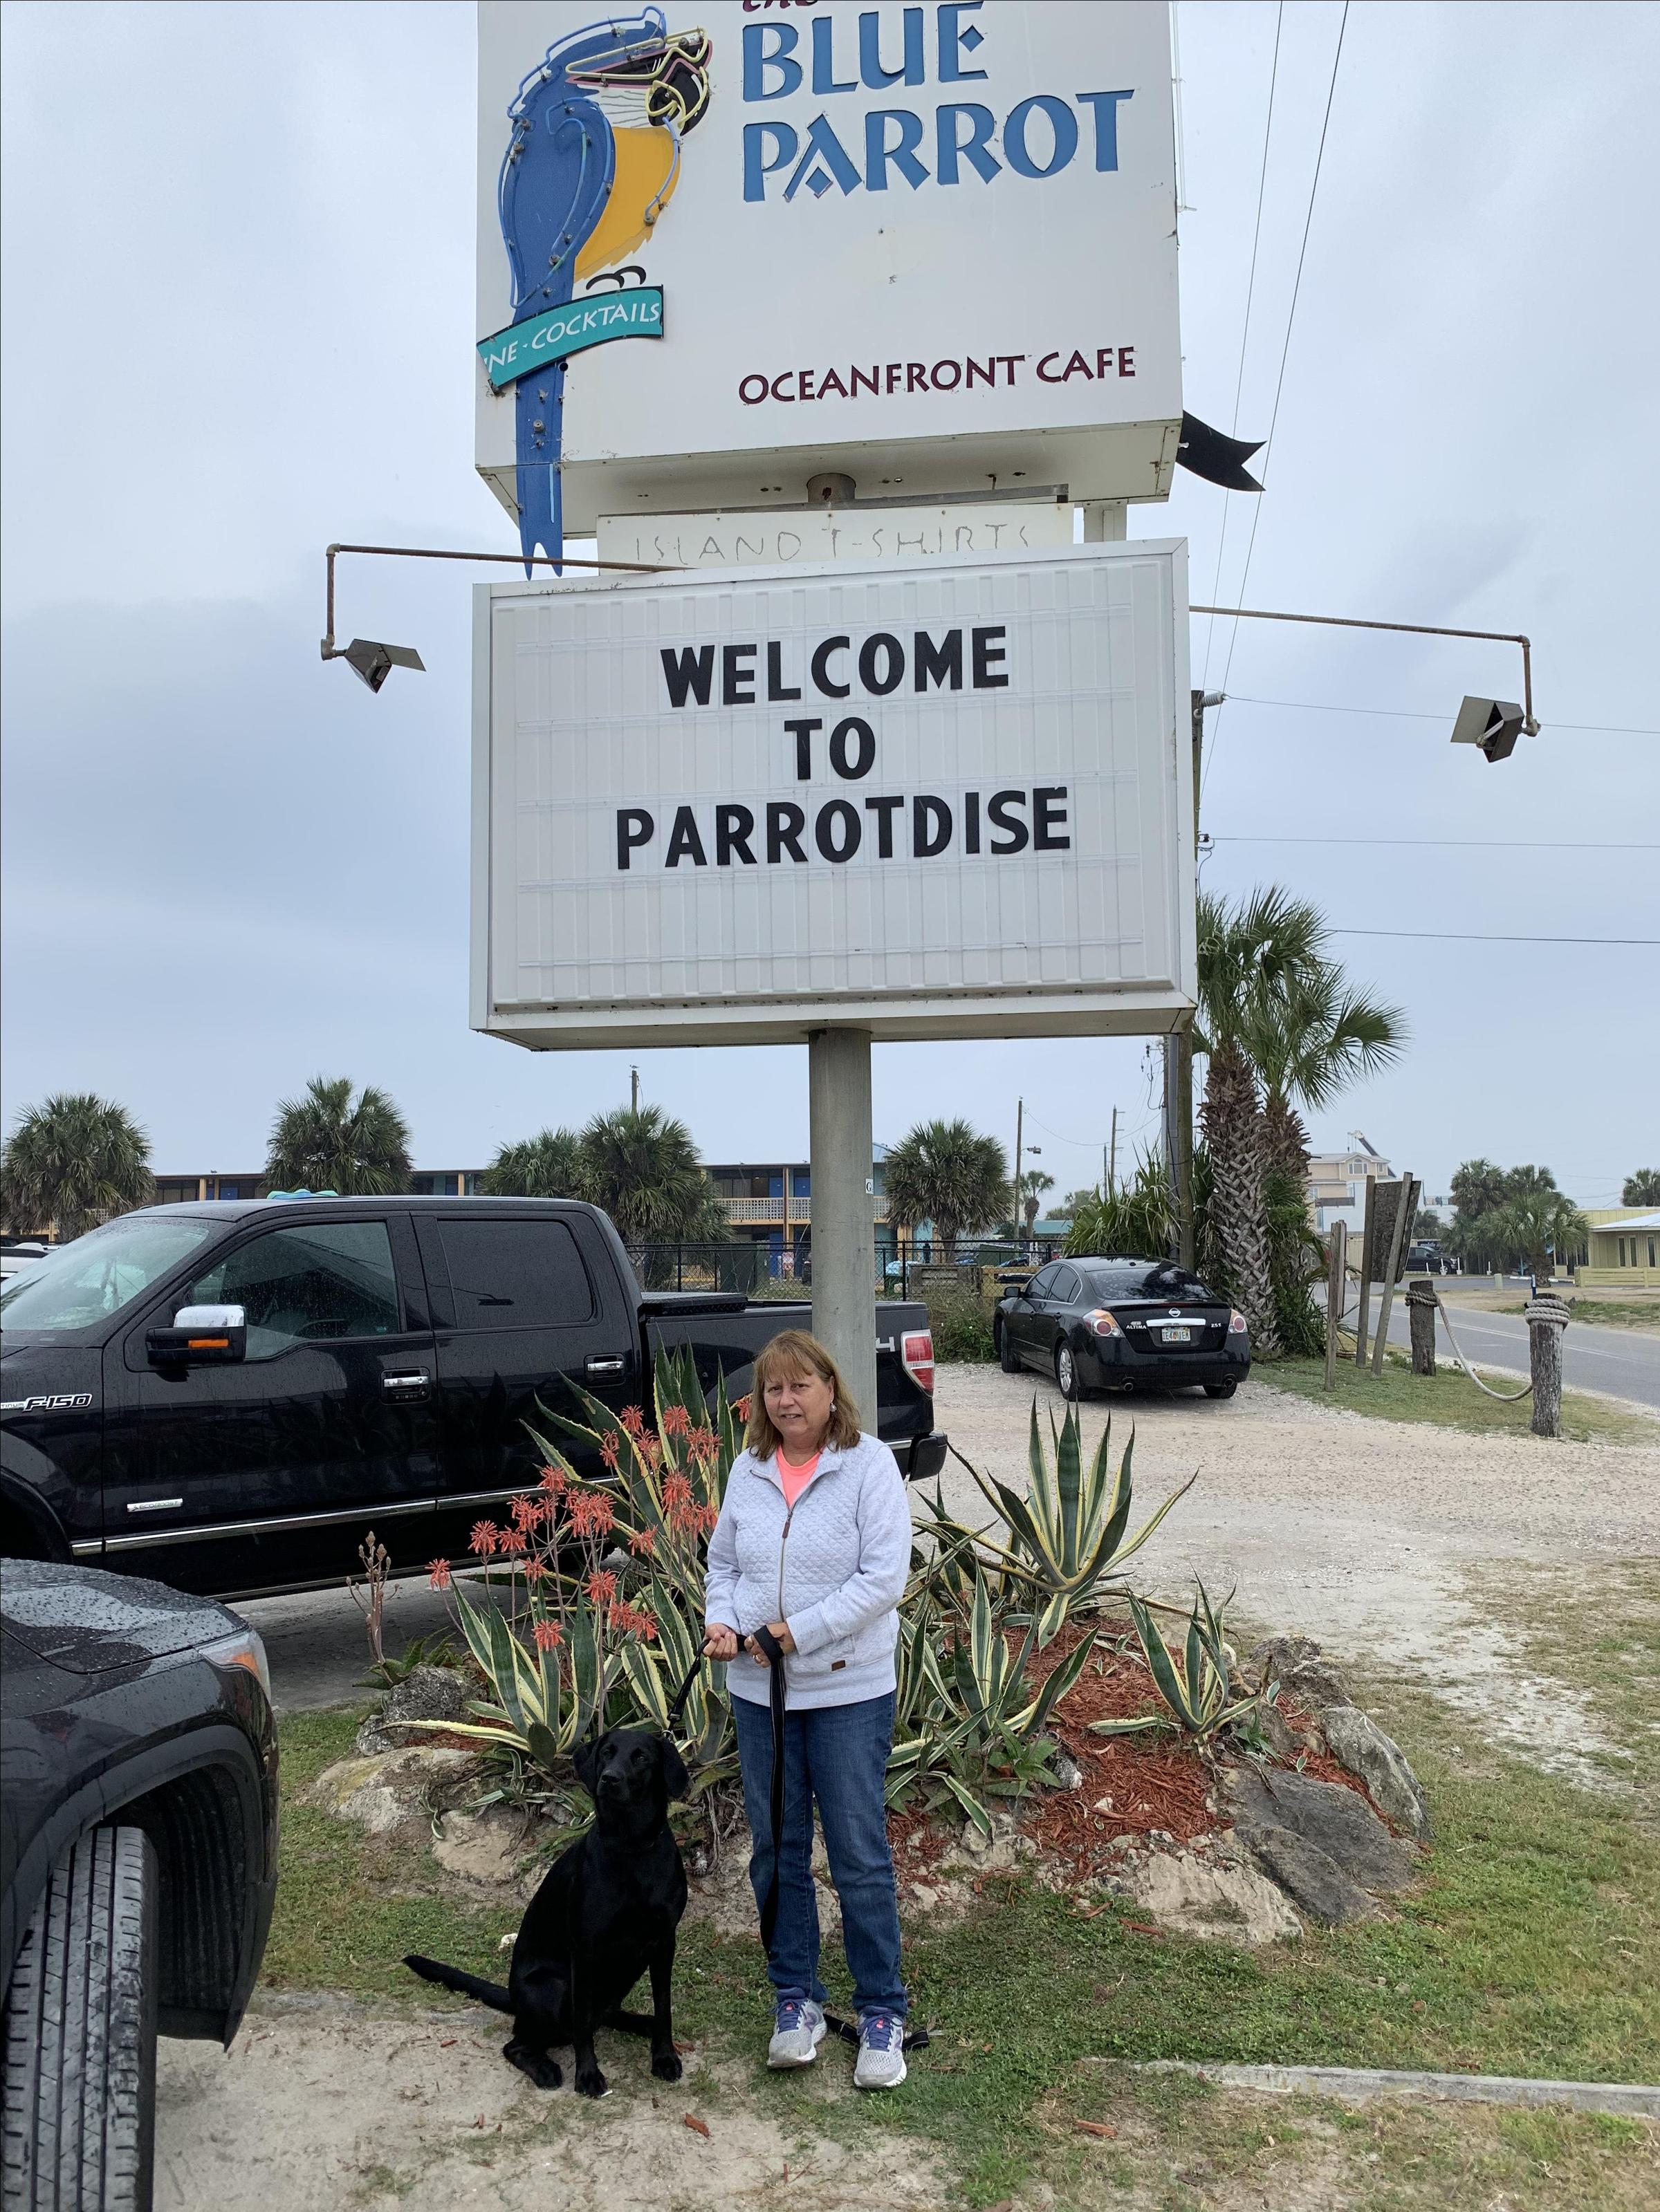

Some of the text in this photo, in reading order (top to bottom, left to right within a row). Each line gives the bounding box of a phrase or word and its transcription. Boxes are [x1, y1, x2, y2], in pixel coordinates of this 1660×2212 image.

[743, 3, 988, 102] BLUE
[743, 90, 1134, 203] PARROT
[739, 346, 1136, 405] OCEANFRONT CAFE
[636, 532, 801, 566] ISLAND
[660, 625, 1009, 708] WELCOME
[784, 716, 876, 781] TO
[616, 786, 1071, 870] PARROTDISE
[23, 1394, 93, 1411] F-150
